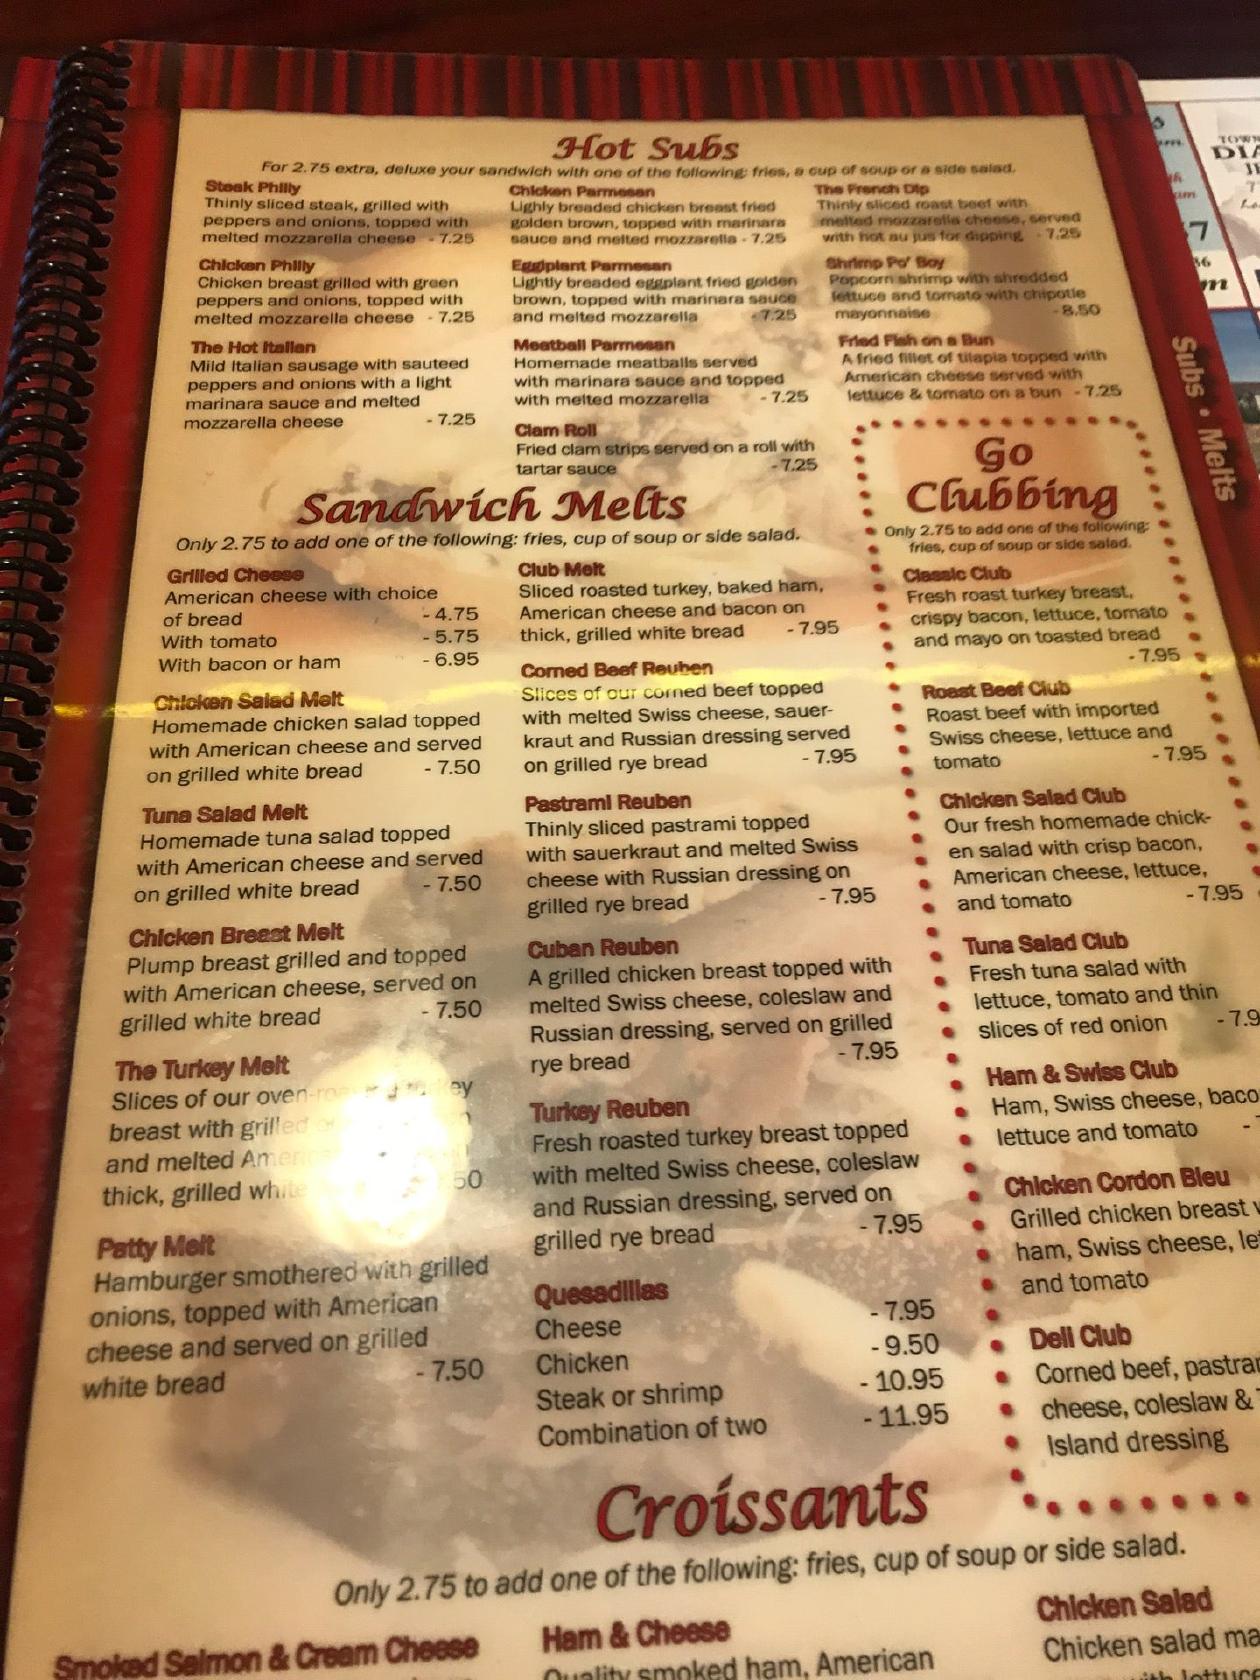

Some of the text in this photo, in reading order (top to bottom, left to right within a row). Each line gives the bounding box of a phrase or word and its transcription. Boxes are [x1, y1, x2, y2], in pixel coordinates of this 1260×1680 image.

[552, 133, 740, 160] Hot Subs
[262, 158, 288, 172] For
[292, 159, 330, 173] 2.75
[335, 160, 378, 175] extra,
[384, 161, 436, 174] deluxe
[441, 164, 476, 178] your
[478, 162, 552, 176] sandwich
[557, 163, 589, 177] with
[593, 166, 623, 177] one
[626, 164, 644, 177] of
[647, 164, 672, 177] the
[752, 163, 790, 179] fries,
[808, 165, 837, 179] cup
[841, 163, 857, 176] of
[860, 165, 898, 179] soup
[901, 164, 917, 175] or
[934, 161, 967, 174] side
[205, 179, 301, 196] Steak Philly
[509, 184, 655, 196] Chicken Parmesan
[814, 182, 930, 196] The French Dip
[205, 196, 448, 213] Thinly sliced steak, grilled with
[558, 199, 622, 211] breaded
[626, 199, 685, 211] chicken
[689, 199, 738, 211] breast
[741, 199, 776, 211] fried
[199, 257, 315, 273] Chicken Philly
[511, 258, 672, 274] Eggplant Parmesan
[825, 257, 884, 272] Shrimp
[915, 256, 944, 270] Boy
[191, 339, 316, 353] The Hot Italian
[514, 338, 675, 350] Meatball Parmesan
[838, 333, 994, 347] Fried Fish on a Bun
[515, 422, 597, 437] Clam Roll
[1172, 336, 1237, 502] Subs Melts
[975, 437, 1033, 472] Go
[297, 485, 687, 525] Sandwich Melts
[907, 477, 1118, 520] Clubbing
[167, 566, 304, 583] Grilled Cheese
[518, 562, 605, 576] Club Melt
[903, 566, 1012, 582] Classic Club
[521, 660, 713, 678] Corned Beef Reuben
[155, 691, 344, 710] Chicken Salad Melt
[921, 681, 1071, 699] Roast Beef Club
[525, 793, 691, 812] Pastrami Reuben
[940, 786, 1127, 810] Chicken Salad Club
[142, 802, 308, 825] Tuna Salad Melt
[129, 922, 344, 947] Chicken Breast Melt
[962, 930, 1129, 956] Tuna Salad Club
[528, 937, 679, 958] Cuban Reuben
[969, 956, 1186, 982] Fresh tuna salad with
[115, 1055, 290, 1084] The Turkey Melt
[986, 1058, 1179, 1086] Ham & Swiss Club
[529, 1098, 690, 1127] Turkey Reuben
[1004, 1165, 1230, 1197] Chicken Cordon Bleu
[96, 1234, 215, 1264] Patty Melt
[534, 1279, 669, 1309] Quesadillas
[534, 1316, 621, 1339] Cheese
[885, 1299, 935, 1321] 7.95
[1029, 1324, 1132, 1349] Deli Club
[535, 1350, 629, 1375] Chicken
[885, 1334, 939, 1356] 9.50
[536, 1385, 605, 1410] Steak
[612, 1389, 635, 1407] or
[642, 1381, 723, 1411] shrimp
[876, 1368, 944, 1392] 10.95
[538, 1418, 689, 1447] Combination
[694, 1416, 719, 1439] of
[724, 1414, 767, 1438] two
[879, 1403, 949, 1427] 11.95
[596, 1472, 929, 1542] Croissants
[334, 1529, 1185, 1609] Only 2.75 to add one of the following: fries, cup of soup or side salad.
[1036, 1587, 1214, 1622] Chicken Salad
[542, 1618, 731, 1653] Ham & Cheese
[56, 1637, 480, 1680] Smoked Salmon & Cream Cheese
